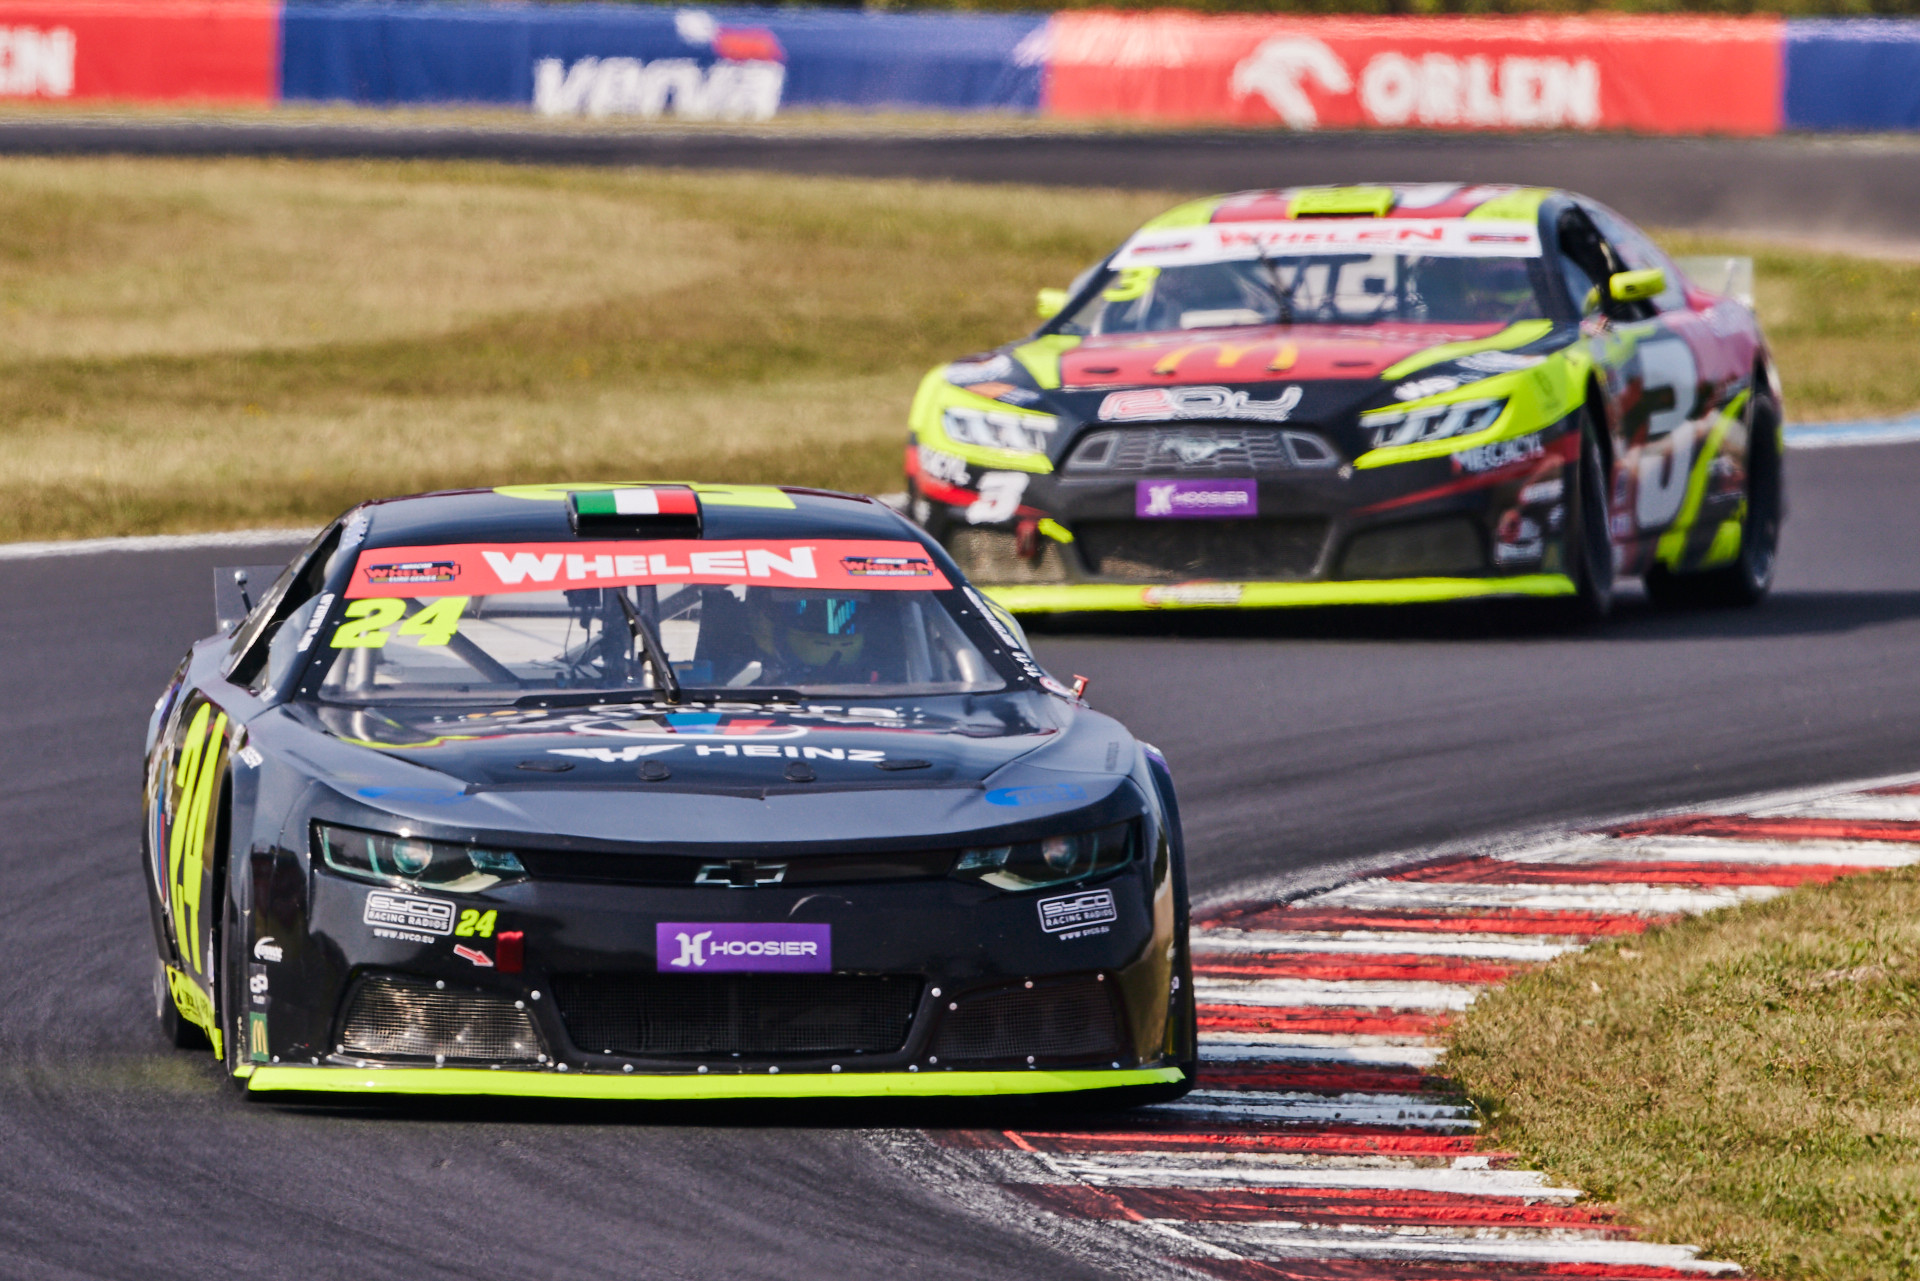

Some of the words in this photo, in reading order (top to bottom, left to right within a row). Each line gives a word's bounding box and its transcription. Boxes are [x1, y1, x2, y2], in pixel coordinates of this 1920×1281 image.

[1358, 52, 1600, 126] ORLEN
[1103, 266, 1161, 302] 3
[1636, 338, 1698, 529] 3
[966, 470, 1030, 525] 3
[482, 546, 817, 583] WHELEN
[330, 596, 470, 648] 24
[695, 745, 889, 762] HEINZ
[370, 895, 450, 918] SYCO
[1042, 894, 1110, 914] SYCO
[1046, 913, 1082, 926] RACING
[1084, 909, 1113, 919] RADIOS
[369, 911, 405, 924] RACING
[408, 917, 448, 930] RADIOS
[455, 909, 498, 938] 24
[710, 940, 818, 956] HOOSIER
